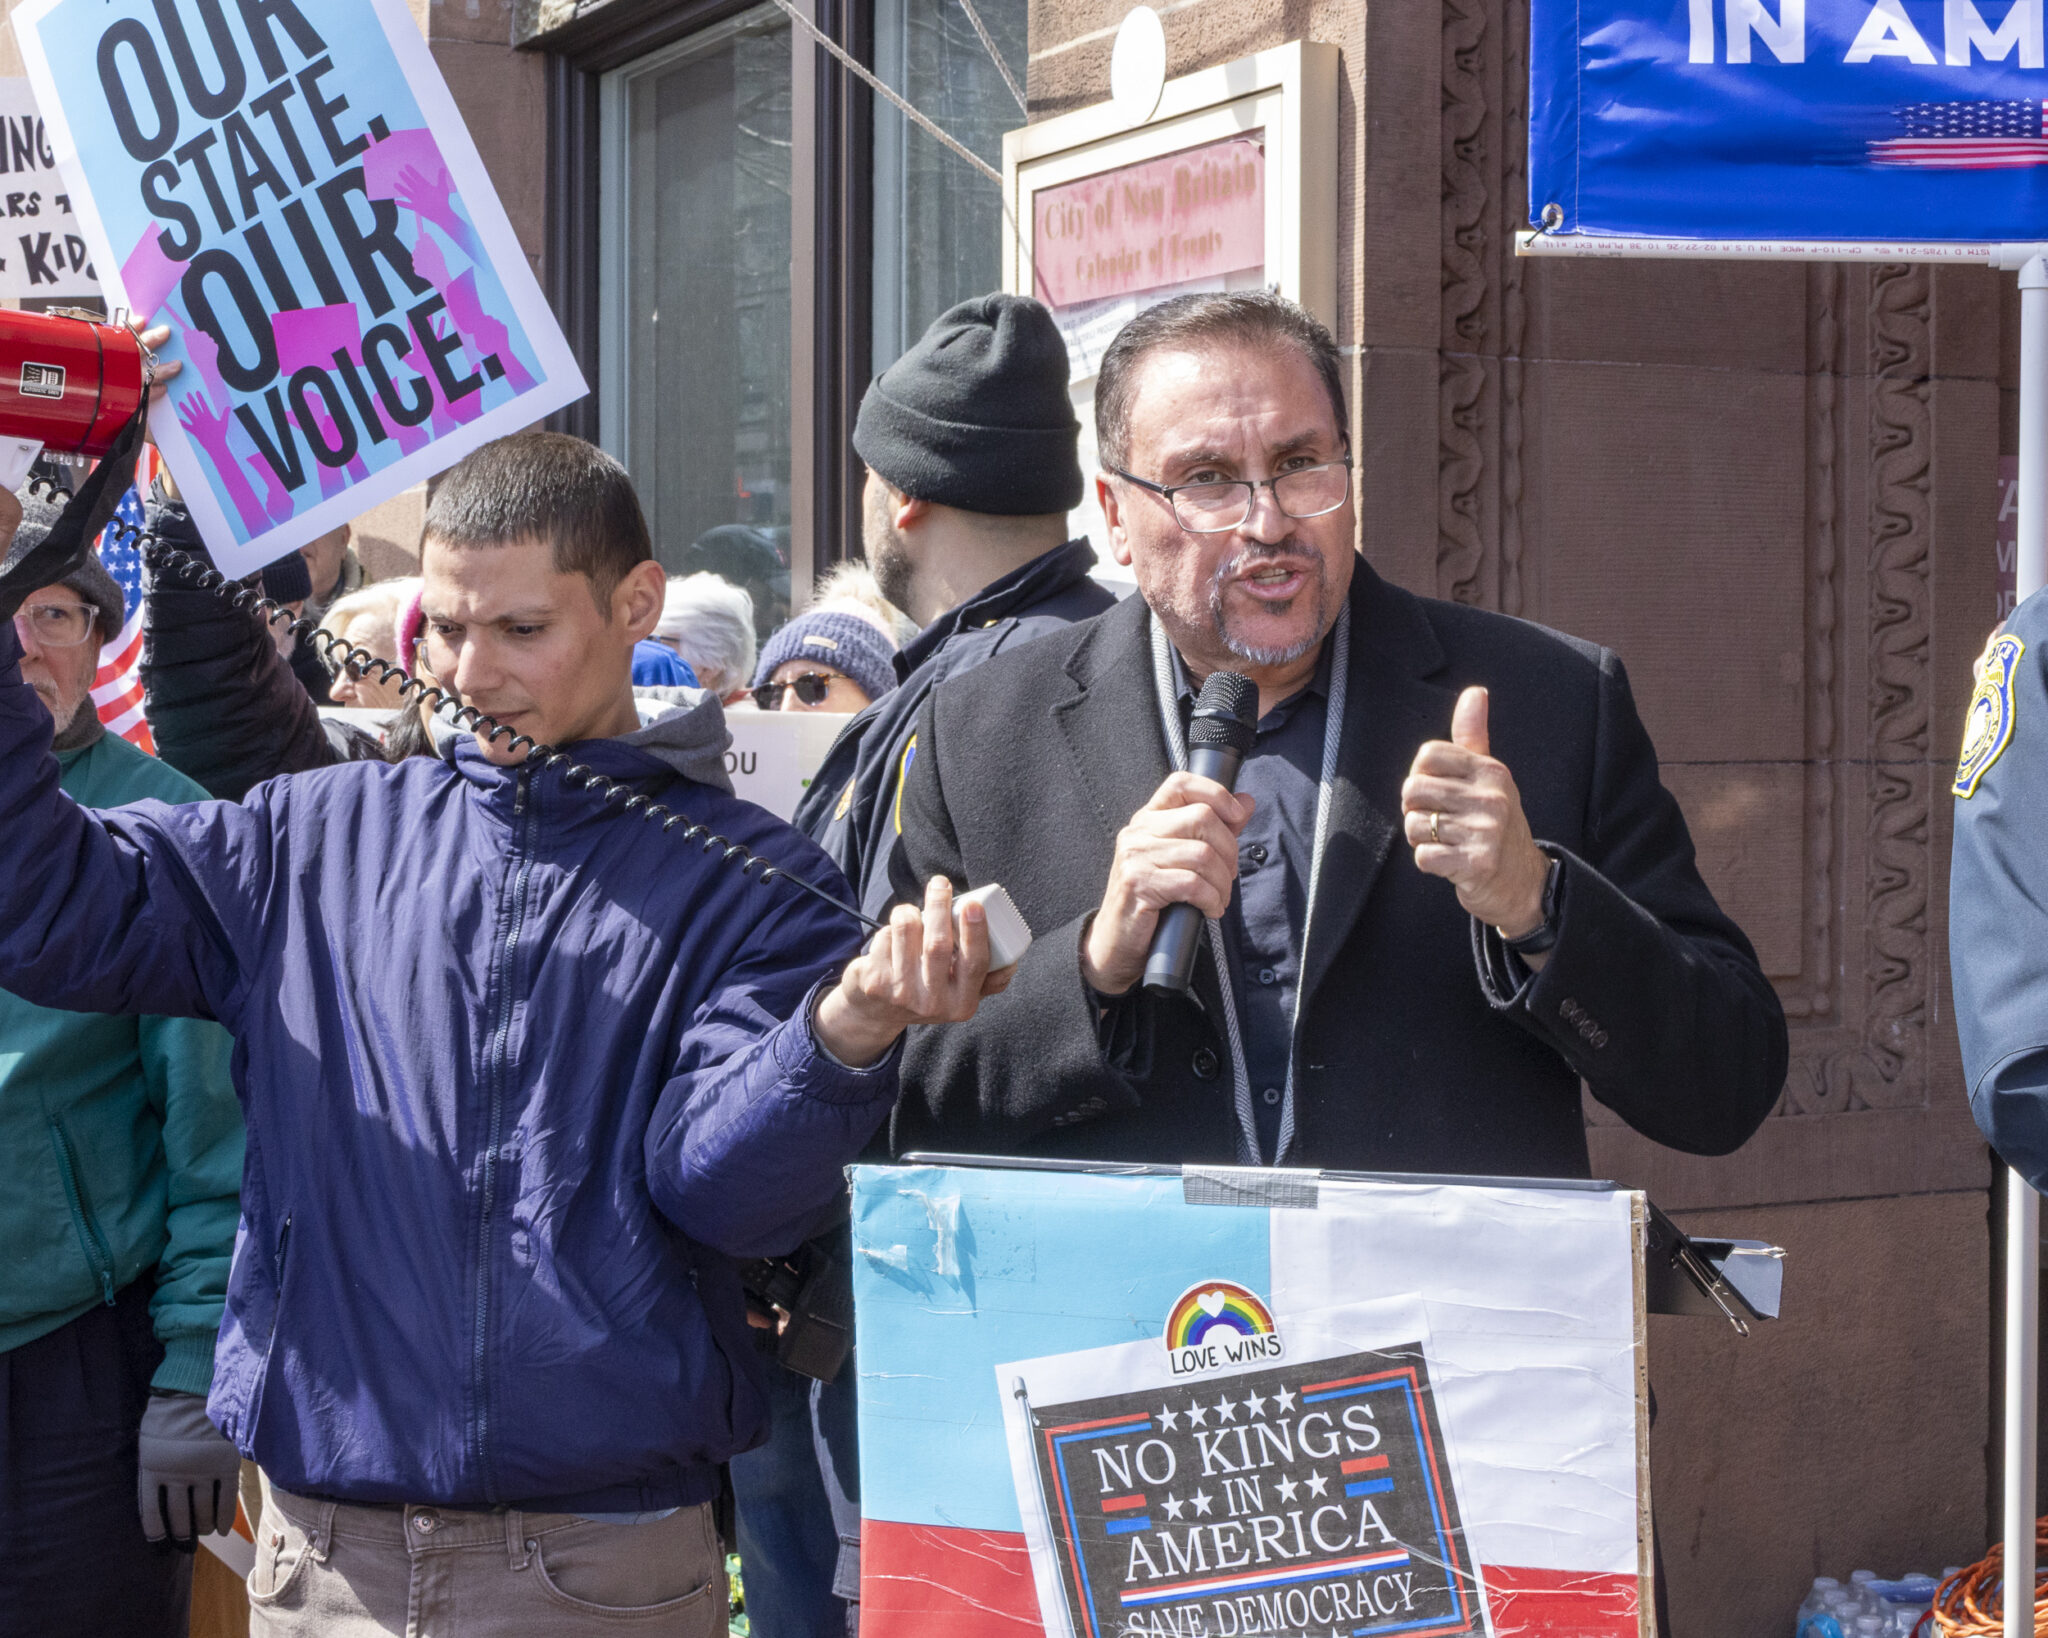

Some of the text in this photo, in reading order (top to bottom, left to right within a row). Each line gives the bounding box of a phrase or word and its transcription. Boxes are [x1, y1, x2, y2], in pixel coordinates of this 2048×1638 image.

[1689, 0, 2045, 69] IN AM
[97, 0, 328, 163] OUR
[140, 55, 391, 261] STATE.
[0, 191, 42, 218] RS
[1044, 152, 1257, 242] City of New Britain
[180, 166, 434, 392] OUR
[1075, 246, 1142, 281] Calendar
[1760, 245, 1772, 253] IN
[233, 293, 506, 492] VOICE.
[723, 751, 757, 775] OU
[1170, 1334, 1282, 1375] LOVE WINS
[1092, 1403, 1382, 1494] NO KINGS
[1221, 1474, 1265, 1517] IN
[1124, 1499, 1398, 1583] AMERICA
[1126, 1571, 1414, 1638] SAVE DEMOCRACY
